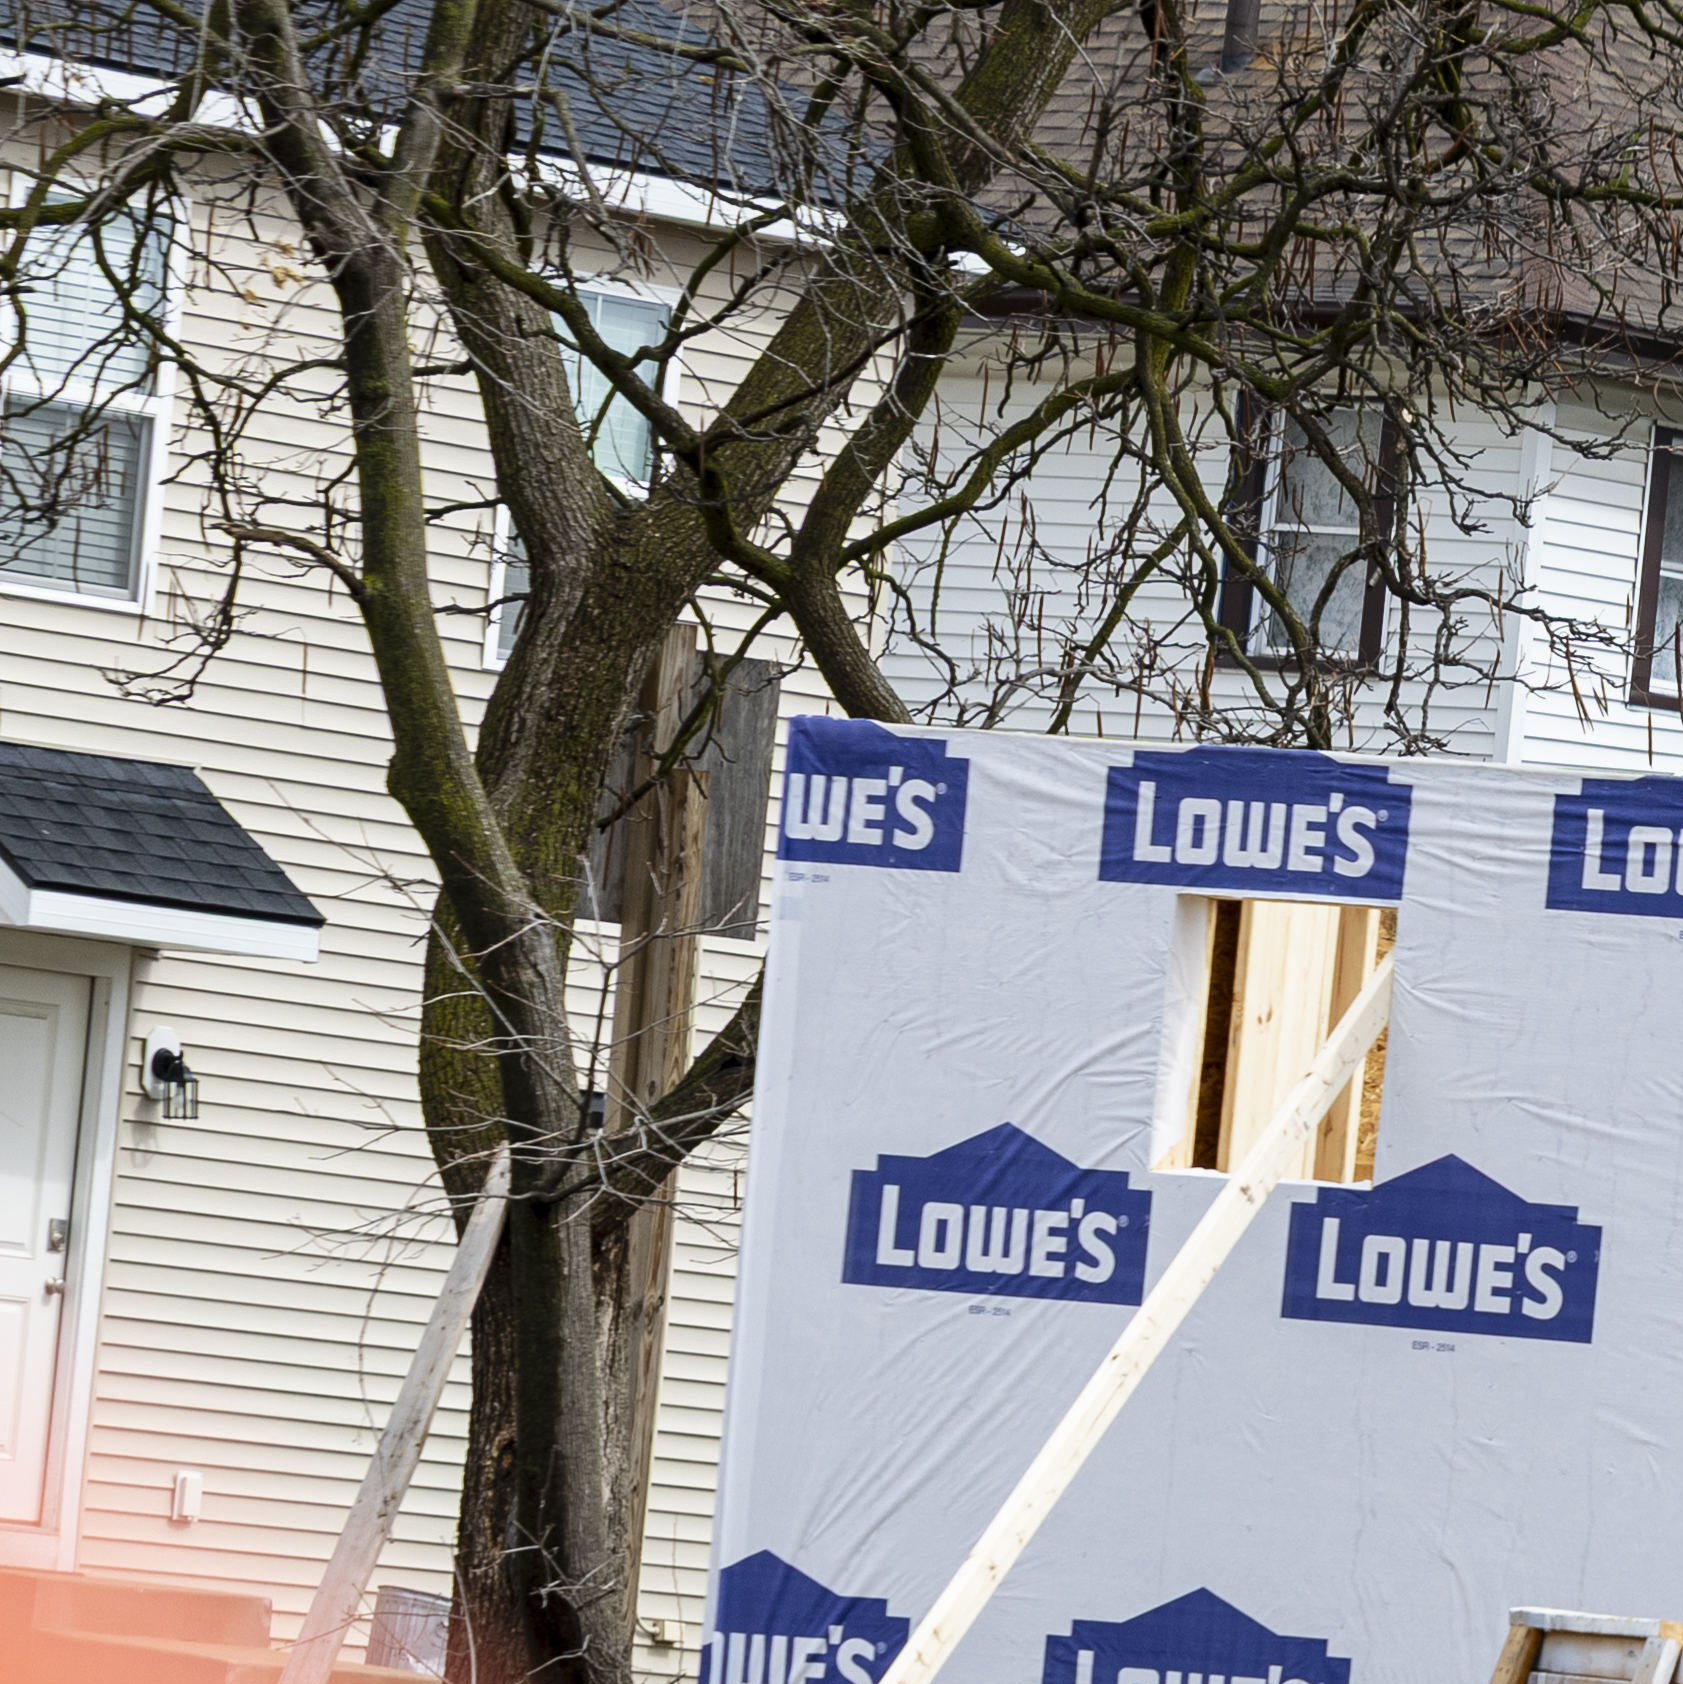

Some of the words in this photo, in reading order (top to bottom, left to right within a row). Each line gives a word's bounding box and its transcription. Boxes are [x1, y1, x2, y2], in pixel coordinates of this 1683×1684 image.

[784, 765, 937, 851] WE'S
[1133, 780, 1377, 878] LOWE'S
[876, 1184, 1118, 1284] LOWE'S
[1316, 1217, 1566, 1320] LOWE'S
